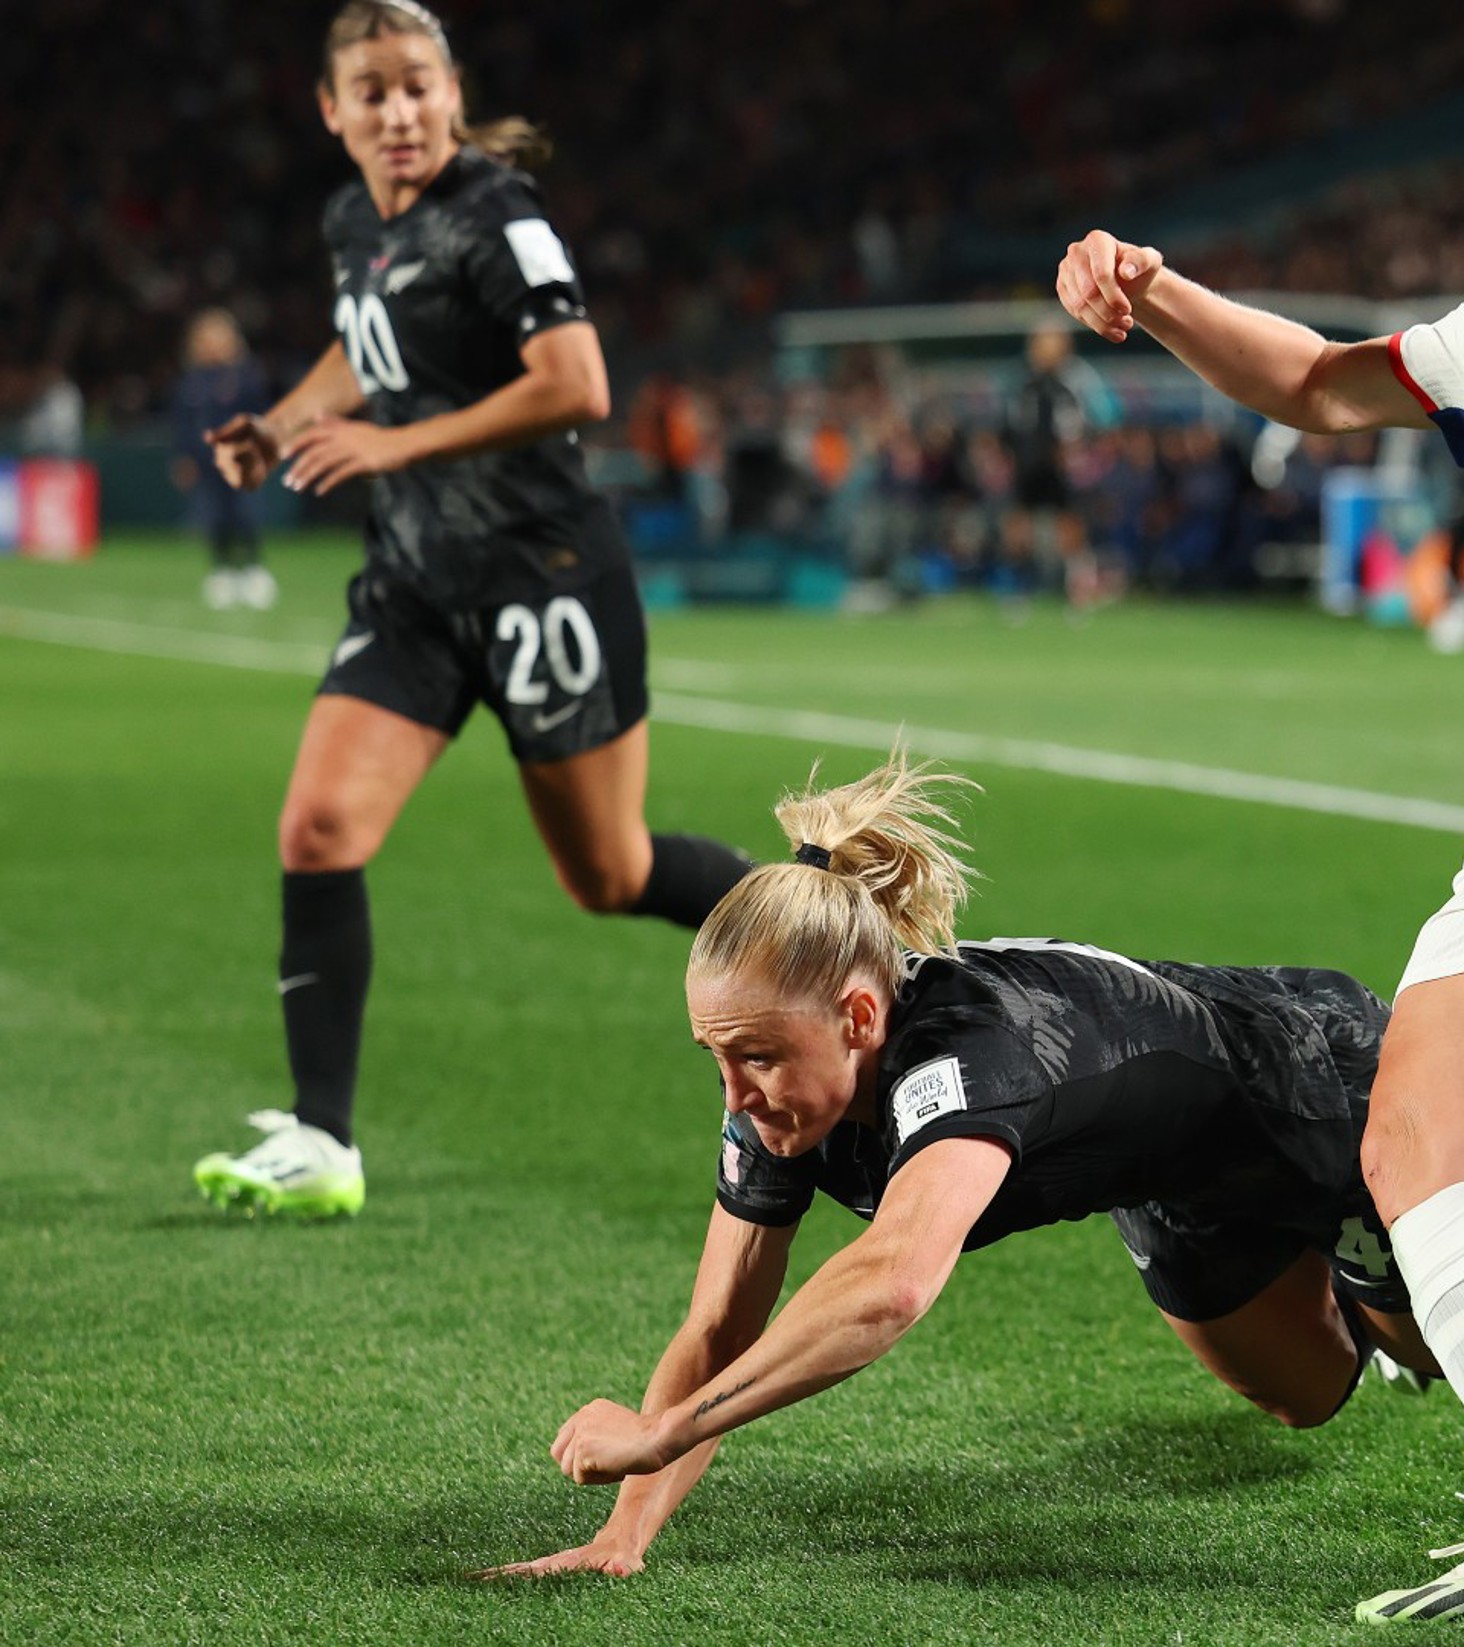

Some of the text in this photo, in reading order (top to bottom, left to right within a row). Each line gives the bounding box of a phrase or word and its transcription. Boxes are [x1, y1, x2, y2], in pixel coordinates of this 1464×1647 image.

[334, 293, 409, 394] 20
[496, 595, 600, 706] 20
[905, 1078, 944, 1103] UNITES
[1335, 1216, 1392, 1277] 4
